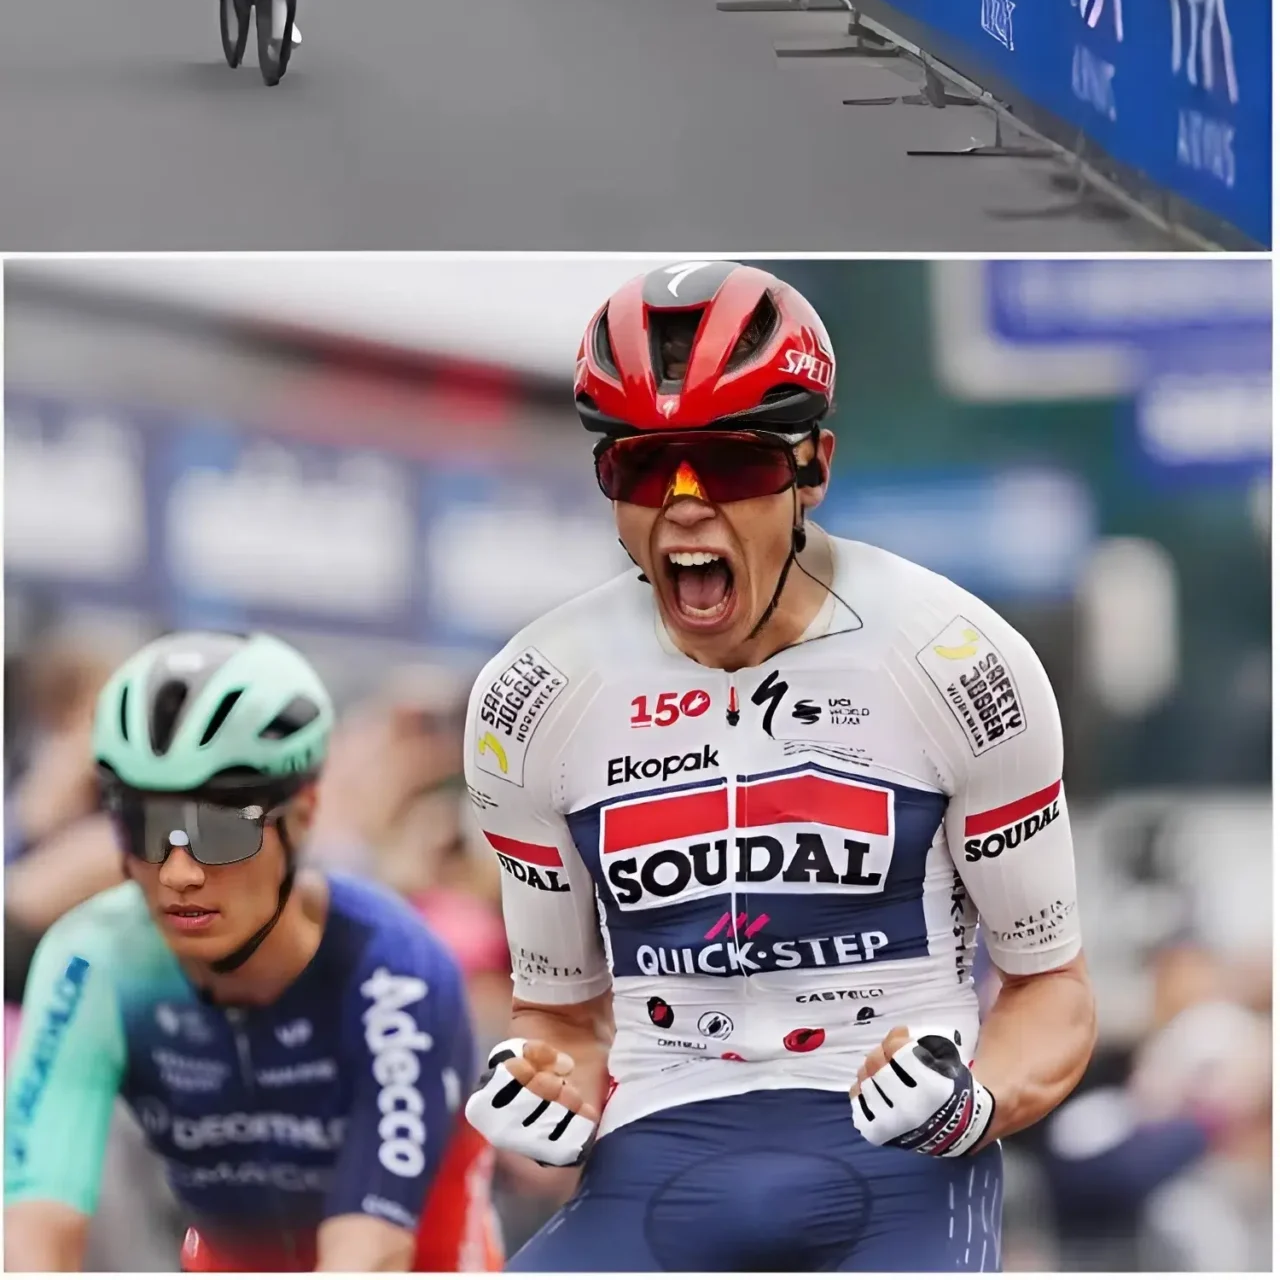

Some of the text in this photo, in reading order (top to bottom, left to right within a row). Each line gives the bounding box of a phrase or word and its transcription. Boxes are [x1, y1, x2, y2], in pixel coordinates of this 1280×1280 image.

[481, 653, 534, 726] SAFETY
[495, 665, 551, 736] JOGGER
[979, 652, 1022, 730] SAFETY
[608, 744, 719, 786] Ekopak
[965, 800, 1060, 862] SOUDAL
[609, 833, 881, 904] SOUDAL
[360, 966, 433, 1175] Adecco
